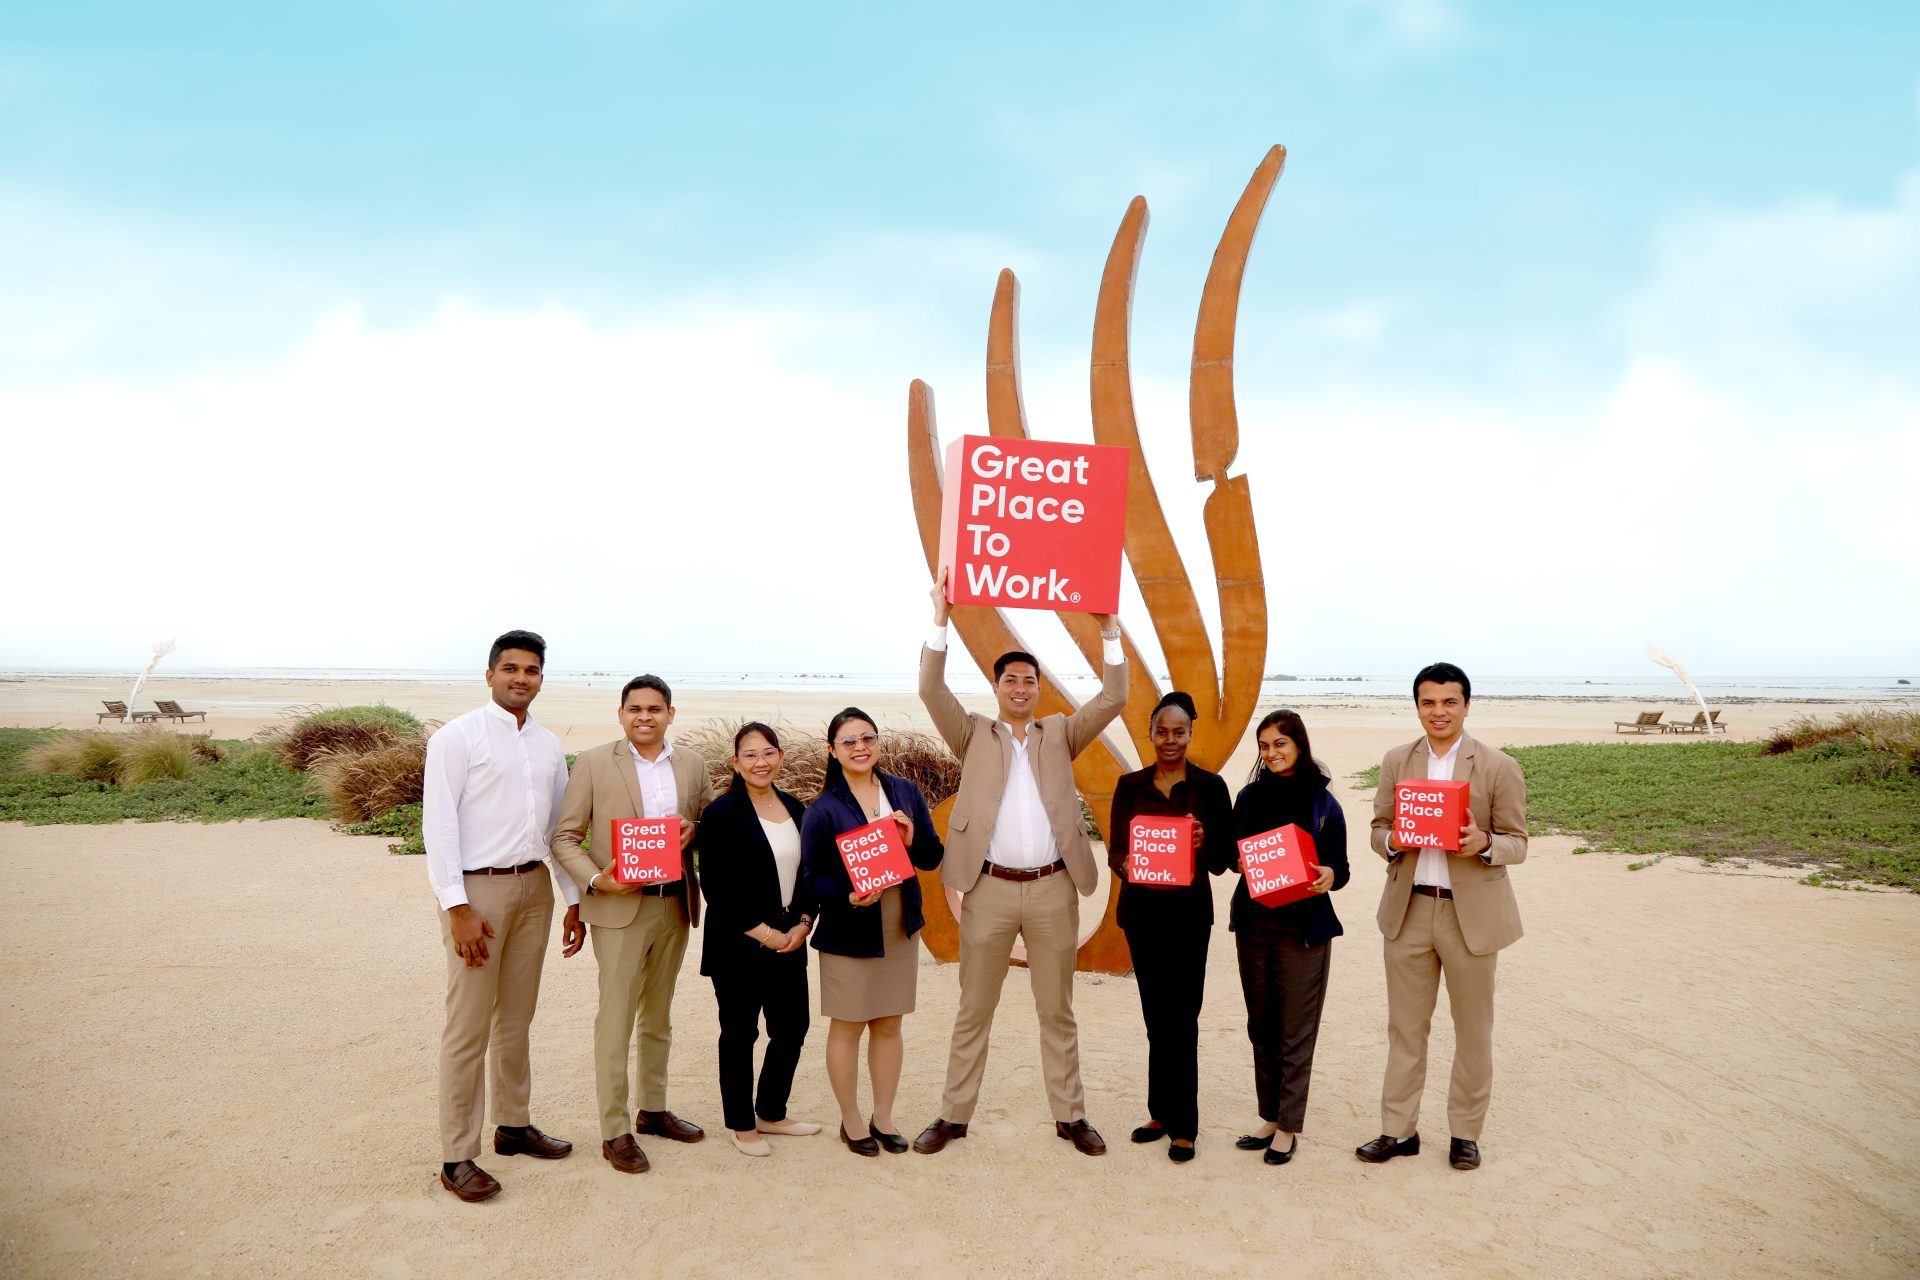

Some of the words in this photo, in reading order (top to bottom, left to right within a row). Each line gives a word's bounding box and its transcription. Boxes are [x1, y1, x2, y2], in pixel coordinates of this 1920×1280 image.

[971, 445, 1090, 486] Great
[971, 484, 1085, 524] Place
[967, 524, 1011, 557] To
[1399, 788, 1445, 803] Great
[1399, 803, 1444, 818] Place
[621, 823, 667, 836] Great
[1399, 817, 1416, 829] To
[1133, 825, 1177, 839] Great
[622, 838, 666, 851] Place
[841, 828, 885, 852] Great
[1134, 839, 1177, 853] Place
[1241, 832, 1284, 854] Great
[622, 853, 639, 865] To
[845, 844, 889, 866] Place
[1133, 854, 1149, 866] To
[1245, 847, 1286, 867] Place
[850, 865, 869, 879] To
[1248, 868, 1265, 880] To
